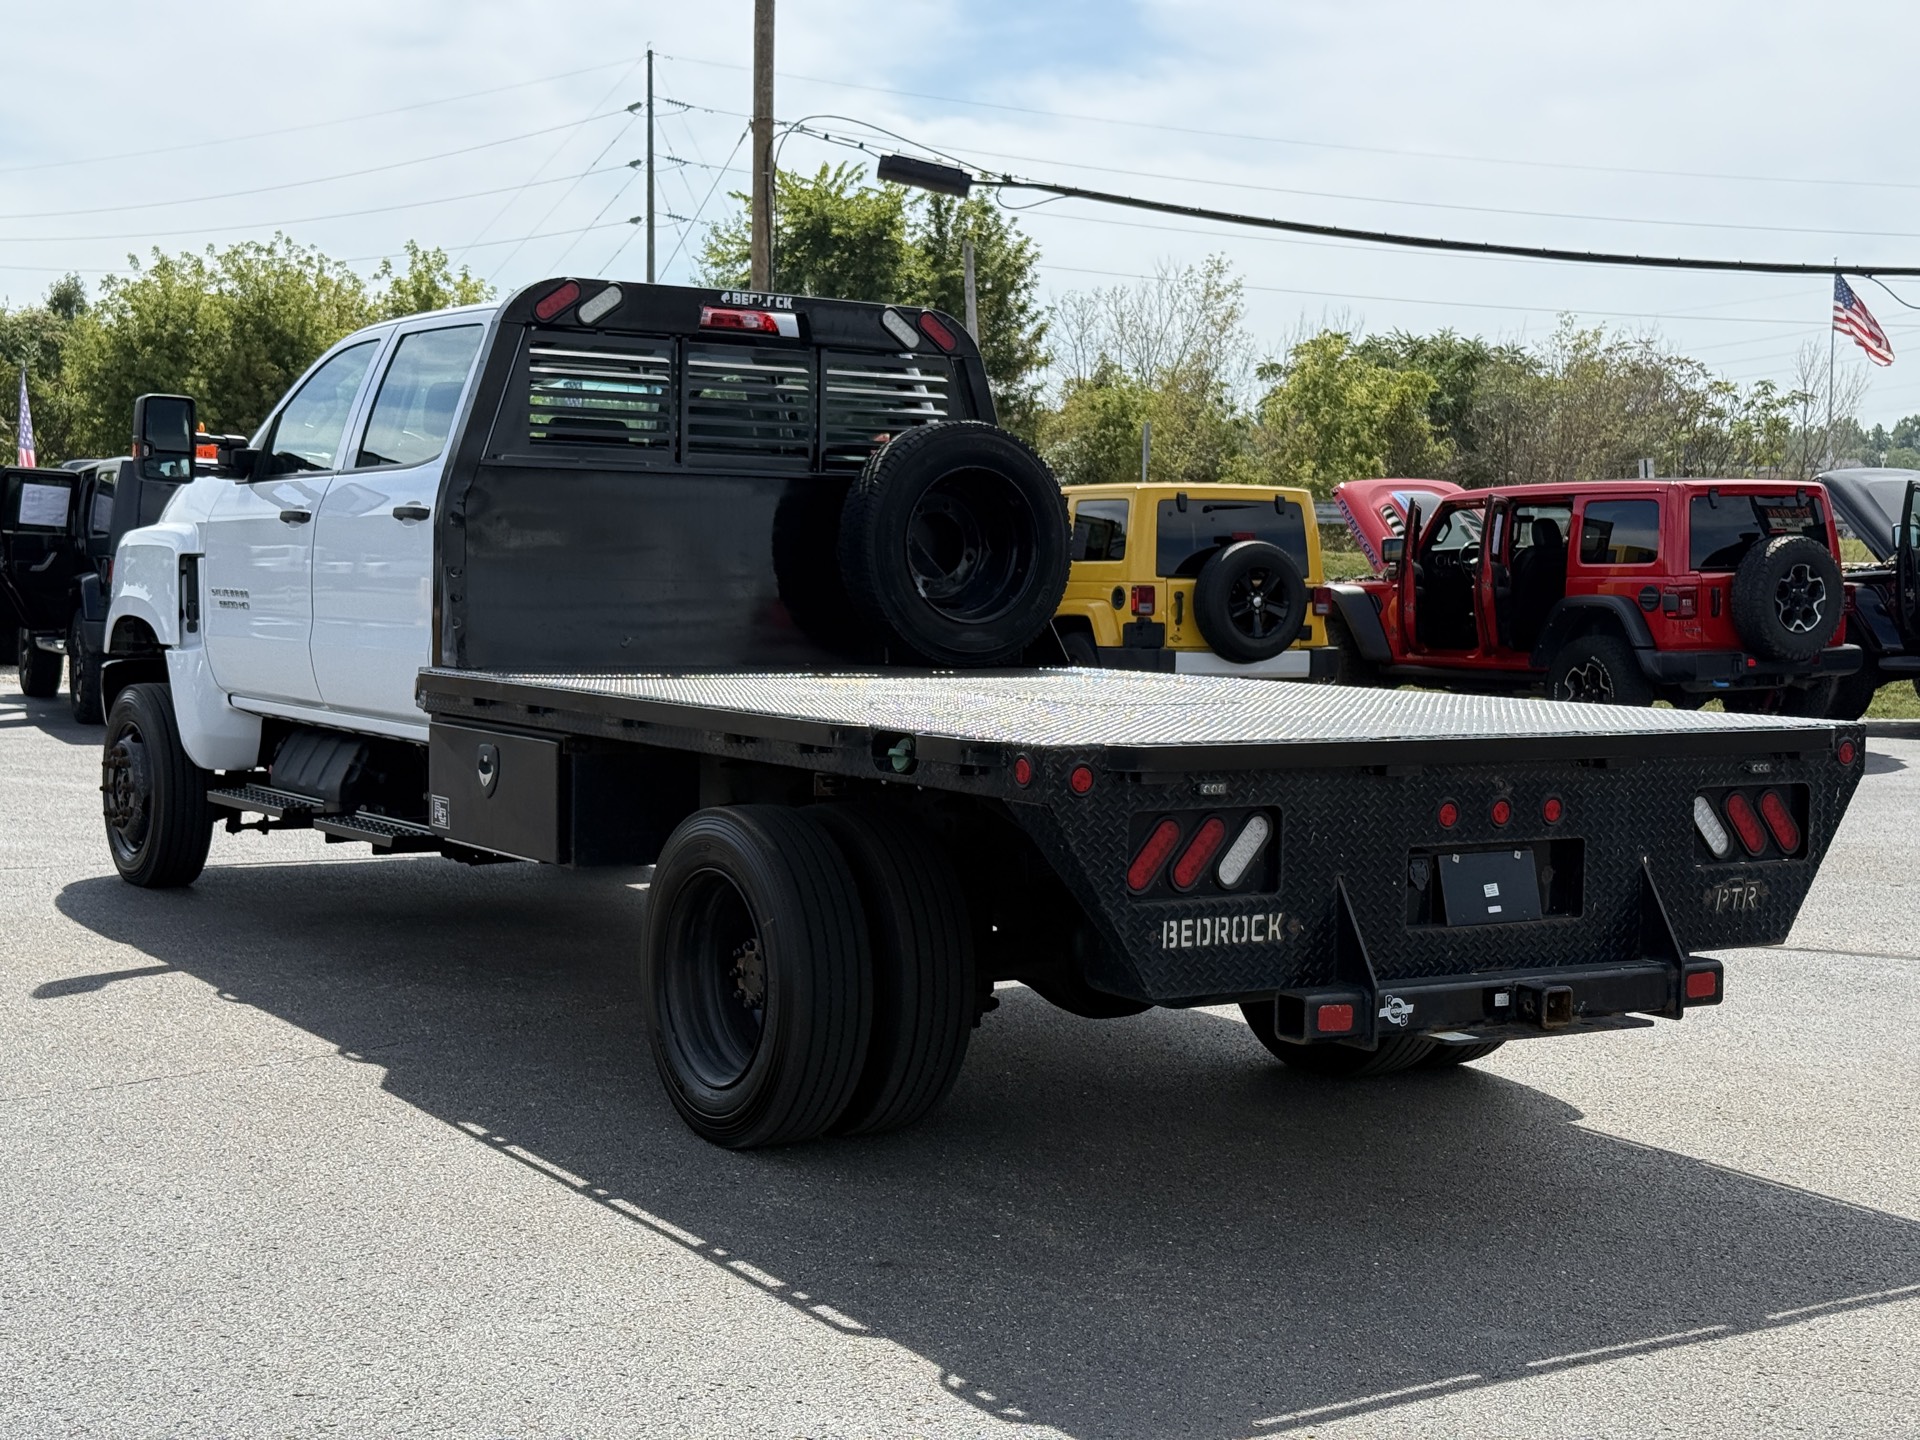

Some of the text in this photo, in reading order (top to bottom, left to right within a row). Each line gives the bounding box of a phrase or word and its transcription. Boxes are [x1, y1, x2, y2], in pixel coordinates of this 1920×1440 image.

[1339, 499, 1378, 566] RUBICON
[1715, 886, 1757, 911] PTR
[1162, 913, 1282, 949] BEDROCK
